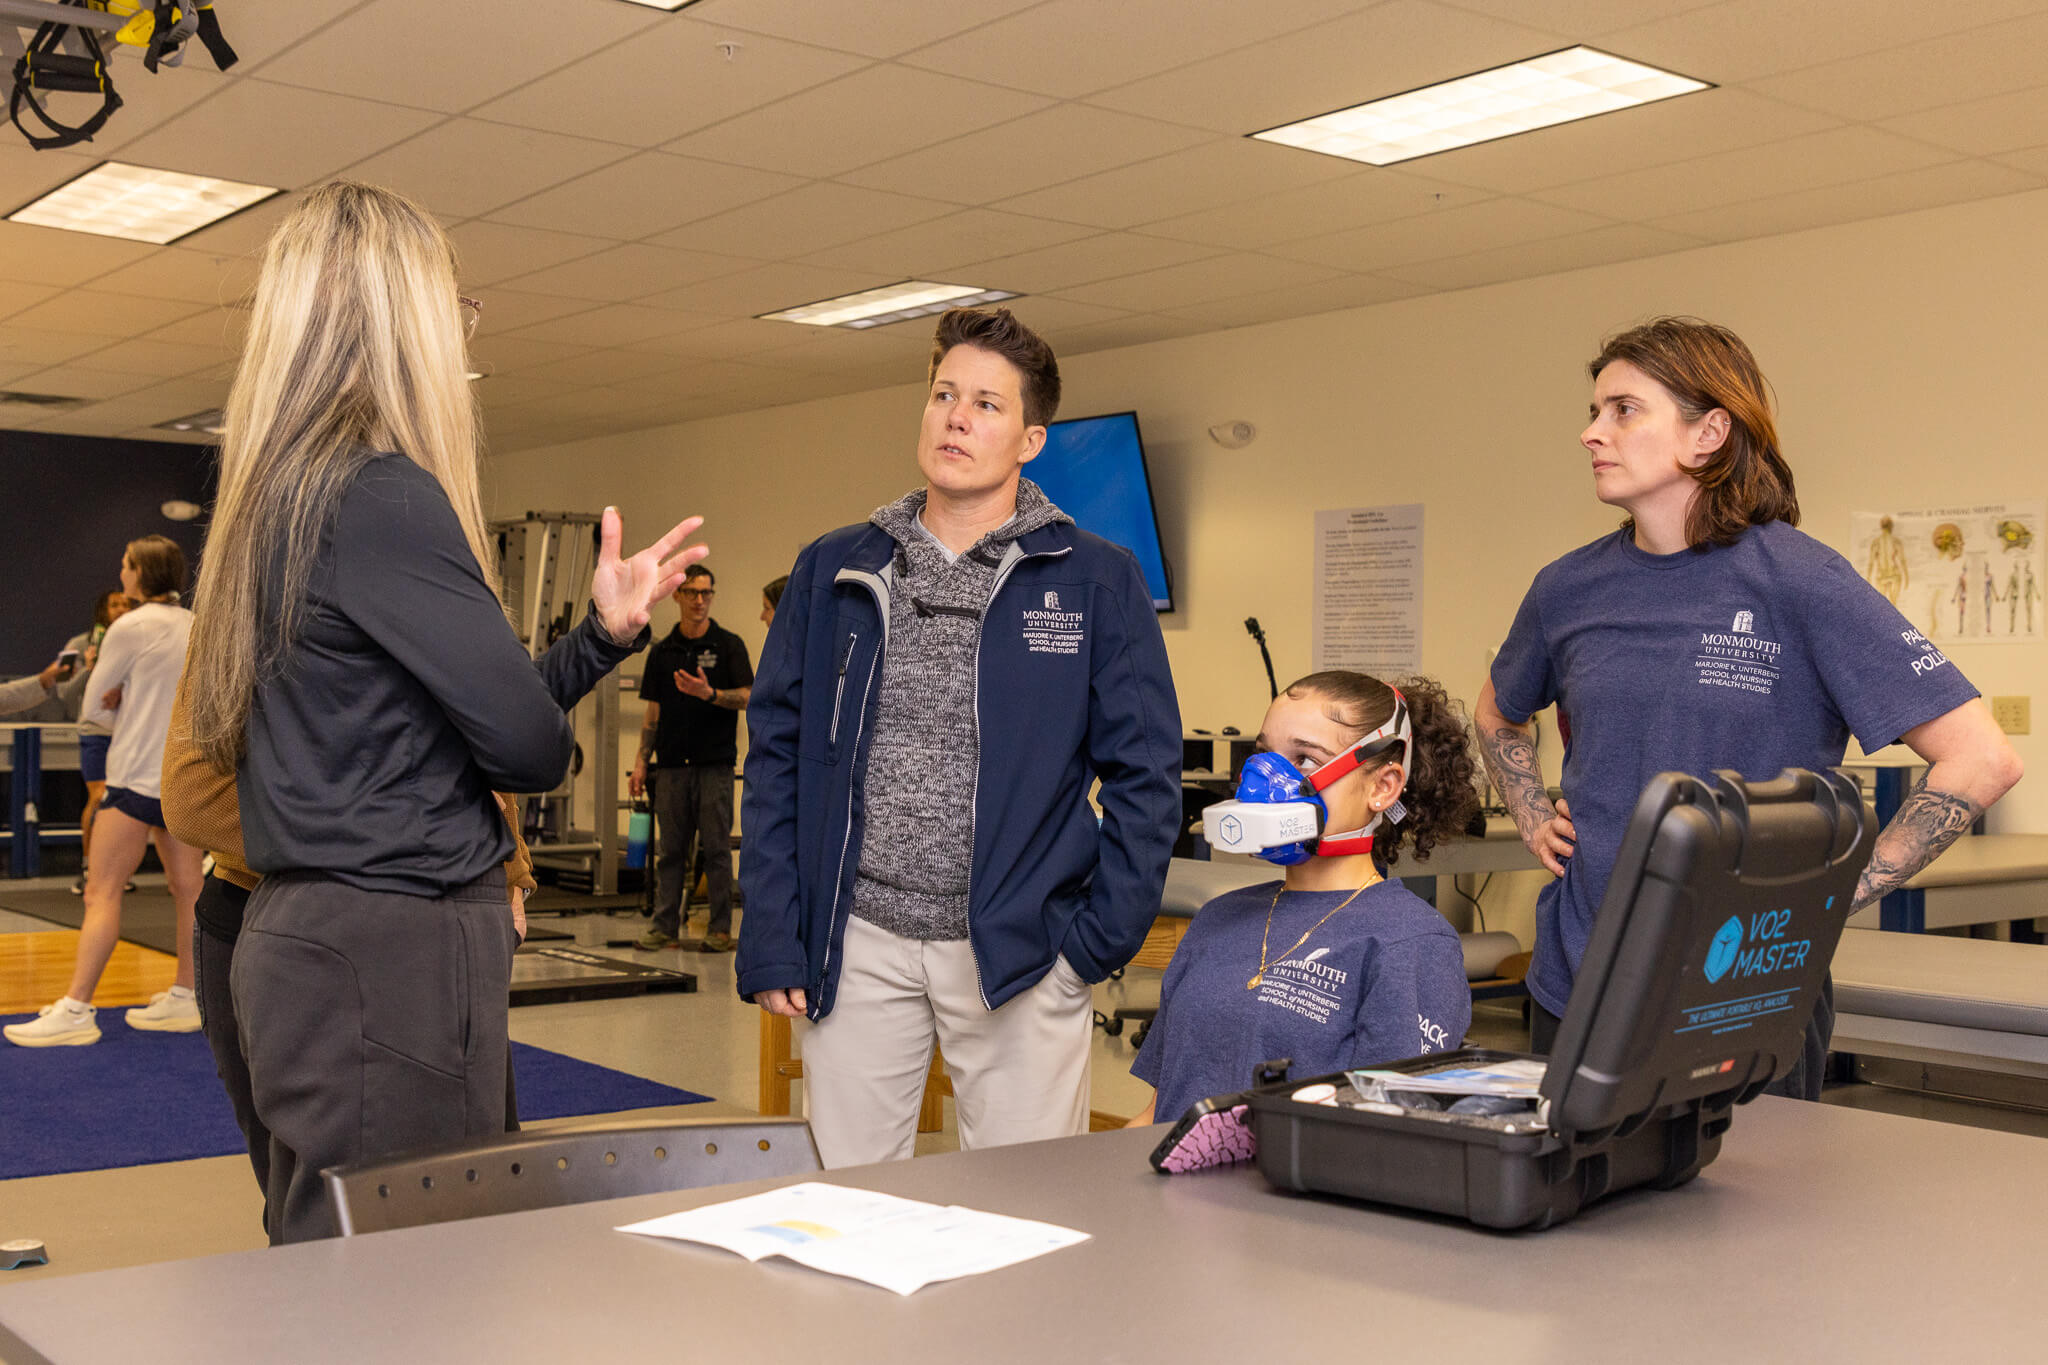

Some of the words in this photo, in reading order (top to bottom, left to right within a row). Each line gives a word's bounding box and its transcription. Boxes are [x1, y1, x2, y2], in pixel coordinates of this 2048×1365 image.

[1023, 611, 1083, 622] MONMOUTH
[1028, 620, 1079, 629] UNIVERSITY
[1701, 633, 1781, 654] MONMOUTH
[1705, 646, 1775, 663] UNIVERSITY
[1695, 661, 1730, 670] MARJORIE
[1738, 665, 1780, 680] UNTERBERG
[1700, 670, 1730, 679] SCHOOL
[1732, 673, 1740, 681] of
[1740, 674, 1773, 686] NURSING
[1712, 679, 1740, 688] HEALTH
[1742, 683, 1771, 694] STUDIES
[1280, 817, 1298, 828] VO2
[1280, 824, 1315, 838] MASTER
[1750, 908, 1792, 942] VO2
[1732, 940, 1811, 980] MASTER
[1273, 967, 1338, 992] UNIVERSITY
[1261, 987, 1288, 1000] SCHOOL
[1297, 998, 1330, 1016] NURSING
[1298, 989, 1340, 1011] UNTERBERG
[1270, 996, 1295, 1011] HEALTH
[1296, 1006, 1327, 1024] STUDIES
